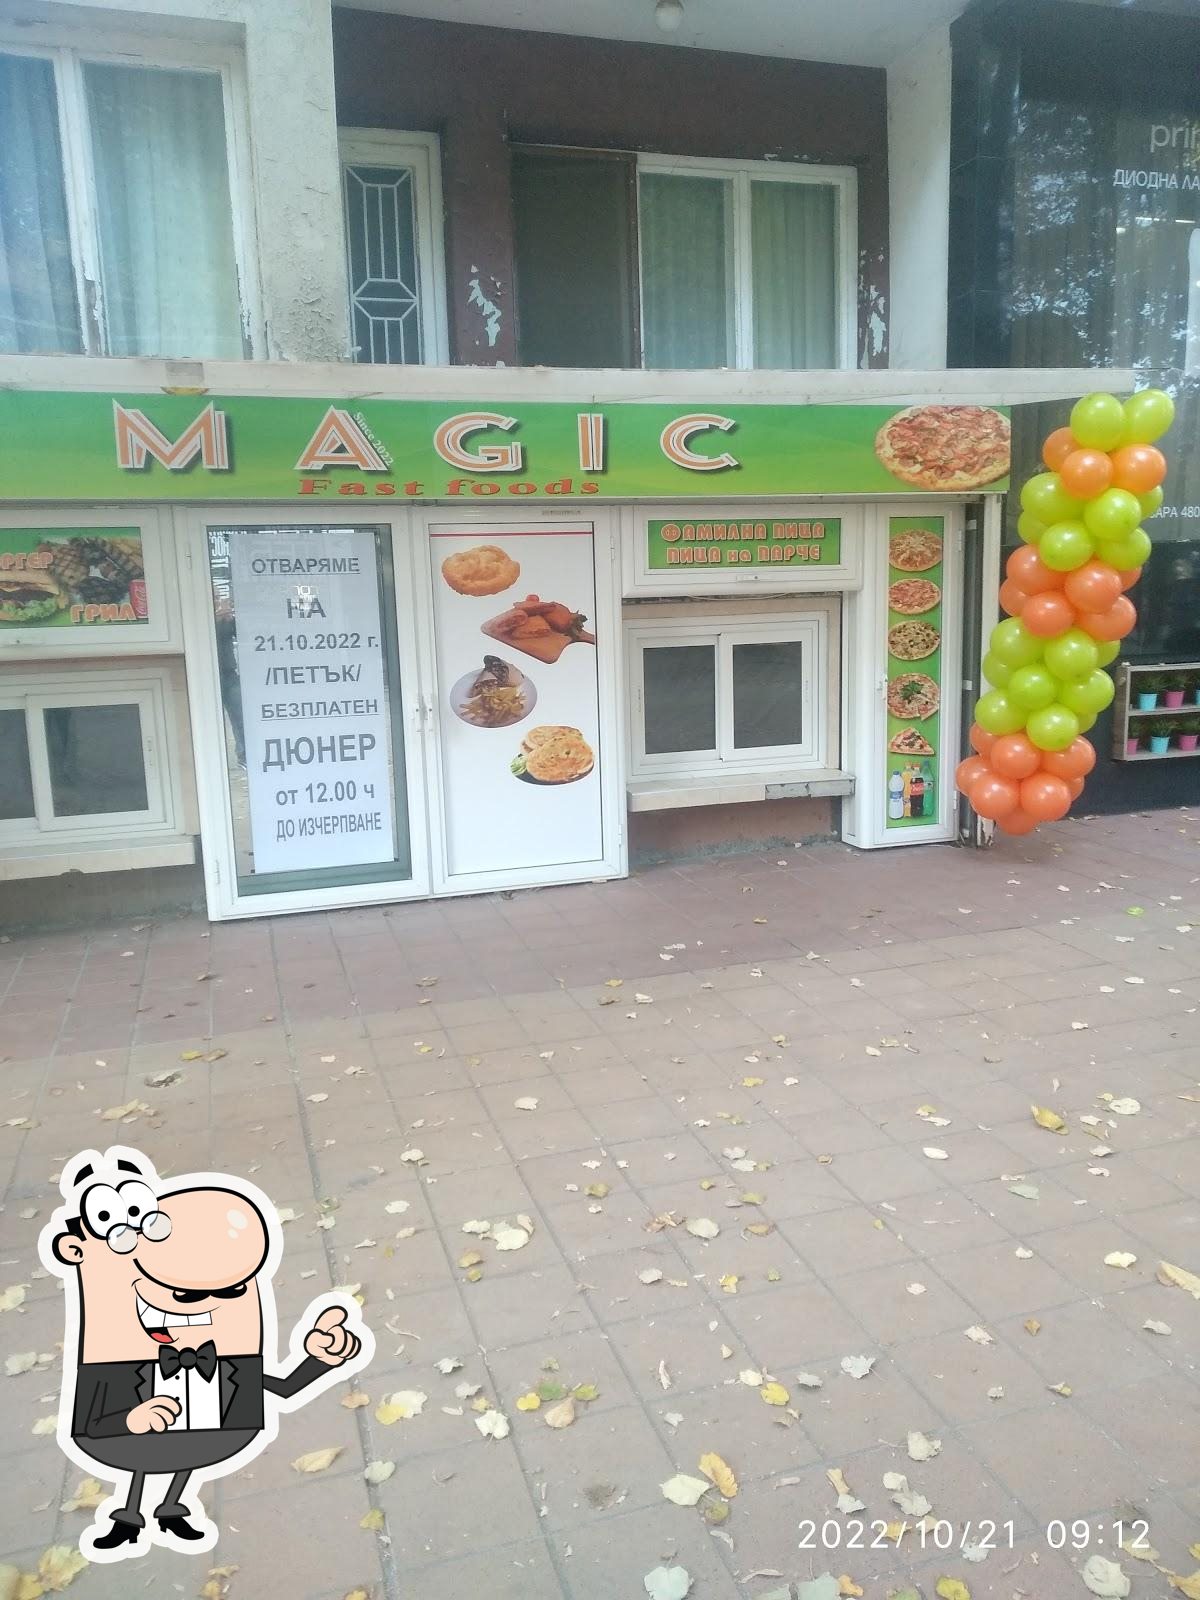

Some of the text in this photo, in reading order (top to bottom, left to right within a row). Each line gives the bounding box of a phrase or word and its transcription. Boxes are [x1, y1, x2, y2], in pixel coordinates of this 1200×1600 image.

[1112, 168, 1179, 190] ДИОДНА
[112, 398, 739, 473] MAGIC
[353, 411, 394, 467] Since 2022
[298, 479, 600, 496] Fast foods
[661, 522, 825, 542] ФАМИЛНА ПИЦА
[667, 546, 721, 564] ПИЦА
[758, 544, 820, 562] ПАРЧЕ
[251, 558, 360, 574] ОТВАРЯМЕ
[70, 603, 136, 623] ГРИЛ
[286, 597, 326, 619] НА
[254, 633, 379, 652] 21.10.2022 г.
[265, 664, 362, 686] /ПЕТЪК/
[261, 699, 378, 719] БЕЗПЛАТЕН
[262, 733, 376, 773] ДЮНЕР
[275, 780, 374, 806] от 12.00 ч
[276, 812, 382, 842] ДО ИЗЧЕРПВАНЕ
